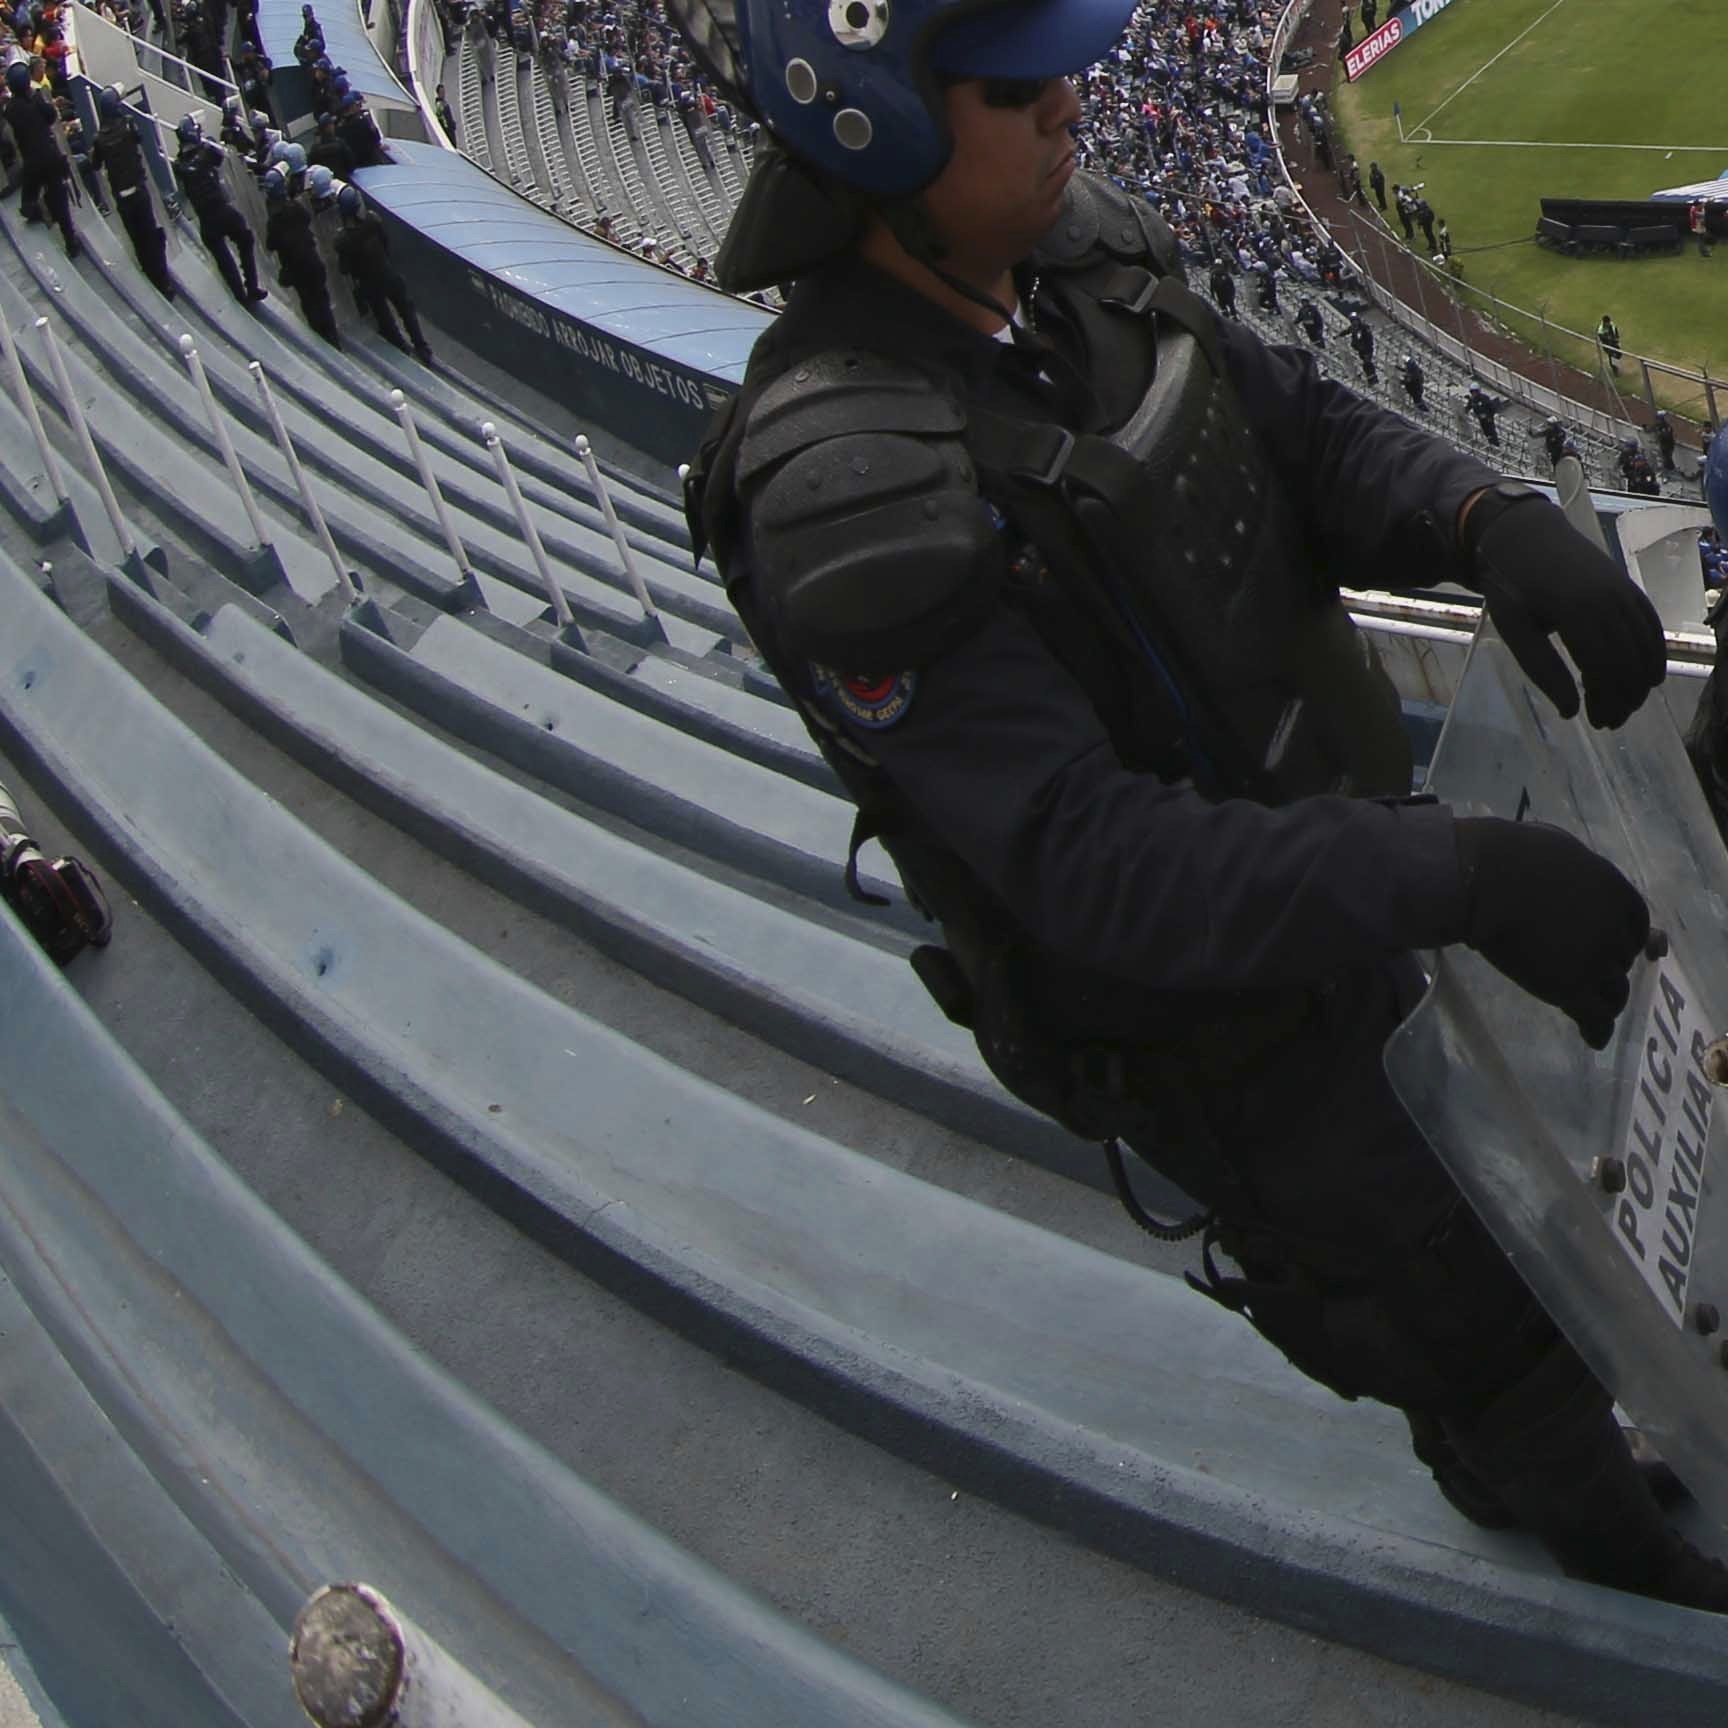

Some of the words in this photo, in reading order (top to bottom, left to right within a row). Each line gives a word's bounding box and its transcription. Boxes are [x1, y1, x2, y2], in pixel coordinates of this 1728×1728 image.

[1347, 20, 1402, 77] ELERIAS
[552, 317, 622, 371] ARROJAR
[621, 350, 705, 411] OBJETOS
[1618, 970, 1686, 1263] POLICIA
